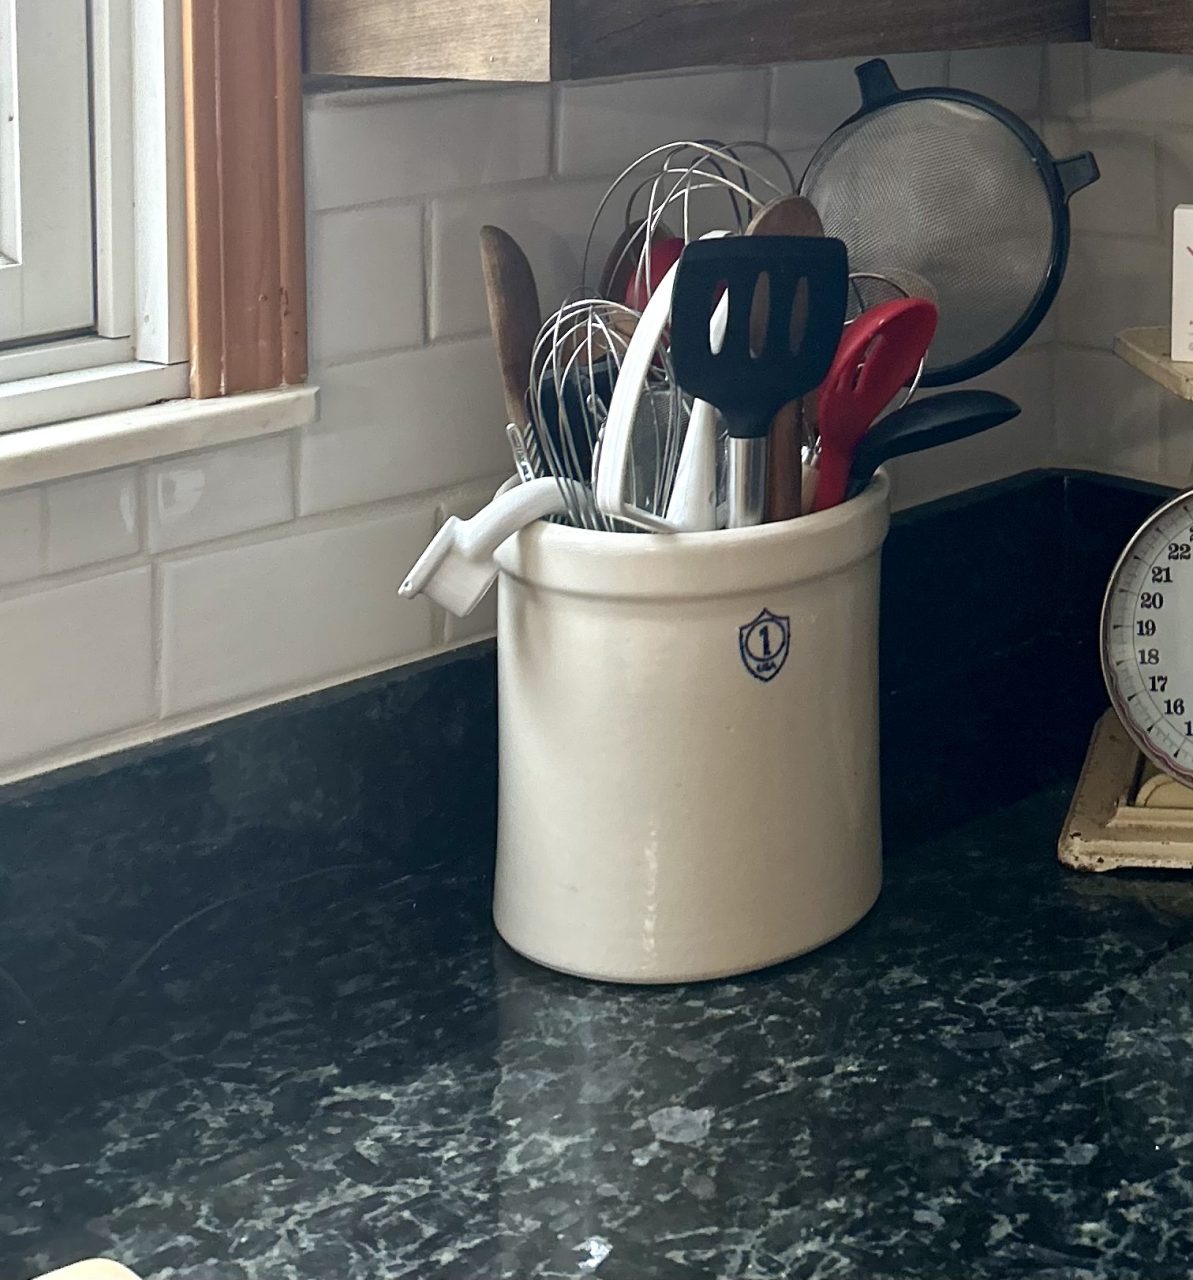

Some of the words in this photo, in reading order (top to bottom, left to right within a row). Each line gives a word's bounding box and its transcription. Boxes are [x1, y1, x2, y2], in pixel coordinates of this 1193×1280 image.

[1168, 543, 1191, 560] 22
[1152, 568, 1173, 583] 21
[1140, 592, 1164, 609] 20
[1136, 620, 1156, 636] 19
[759, 625, 771, 656] 1
[1138, 649, 1159, 665] 18
[1149, 676, 1168, 692] 17
[1164, 699, 1185, 715] 16
